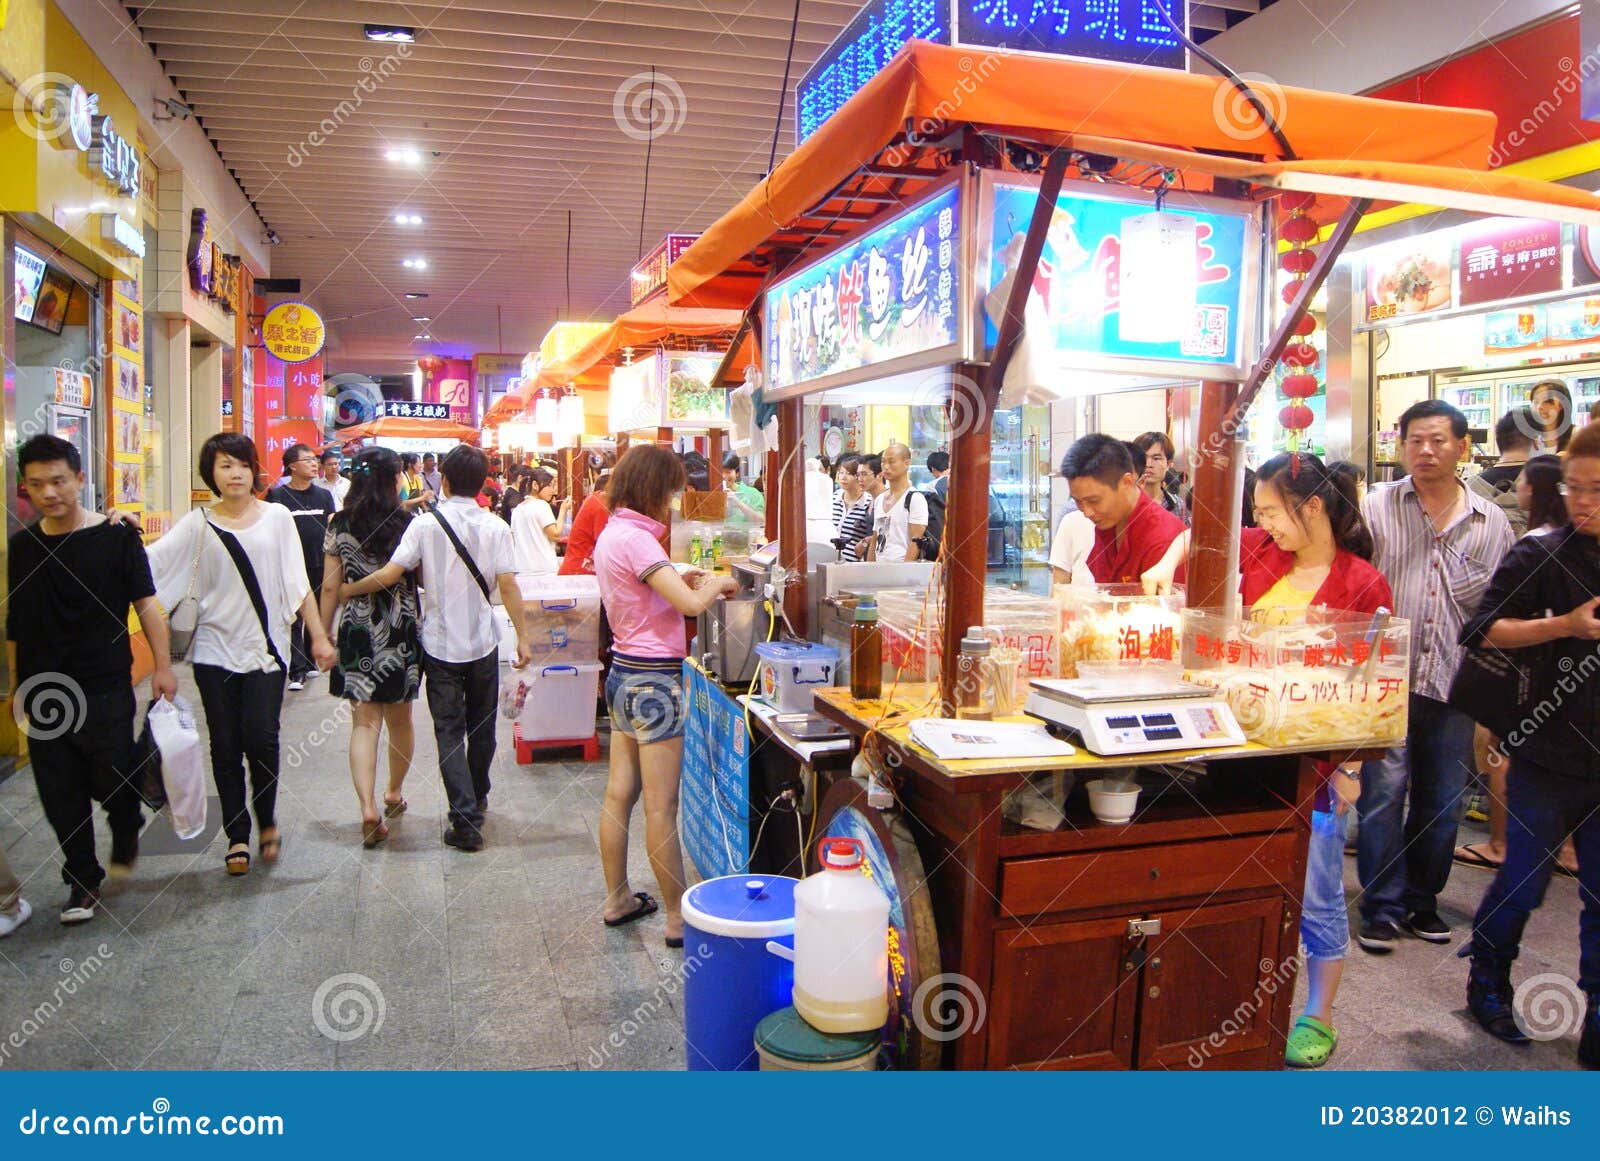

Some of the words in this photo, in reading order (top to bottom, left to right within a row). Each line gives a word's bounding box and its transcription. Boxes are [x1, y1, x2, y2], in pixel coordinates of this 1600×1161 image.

[292, 371, 321, 388] 小吃
[387, 402, 447, 418] 青海老酸奶
